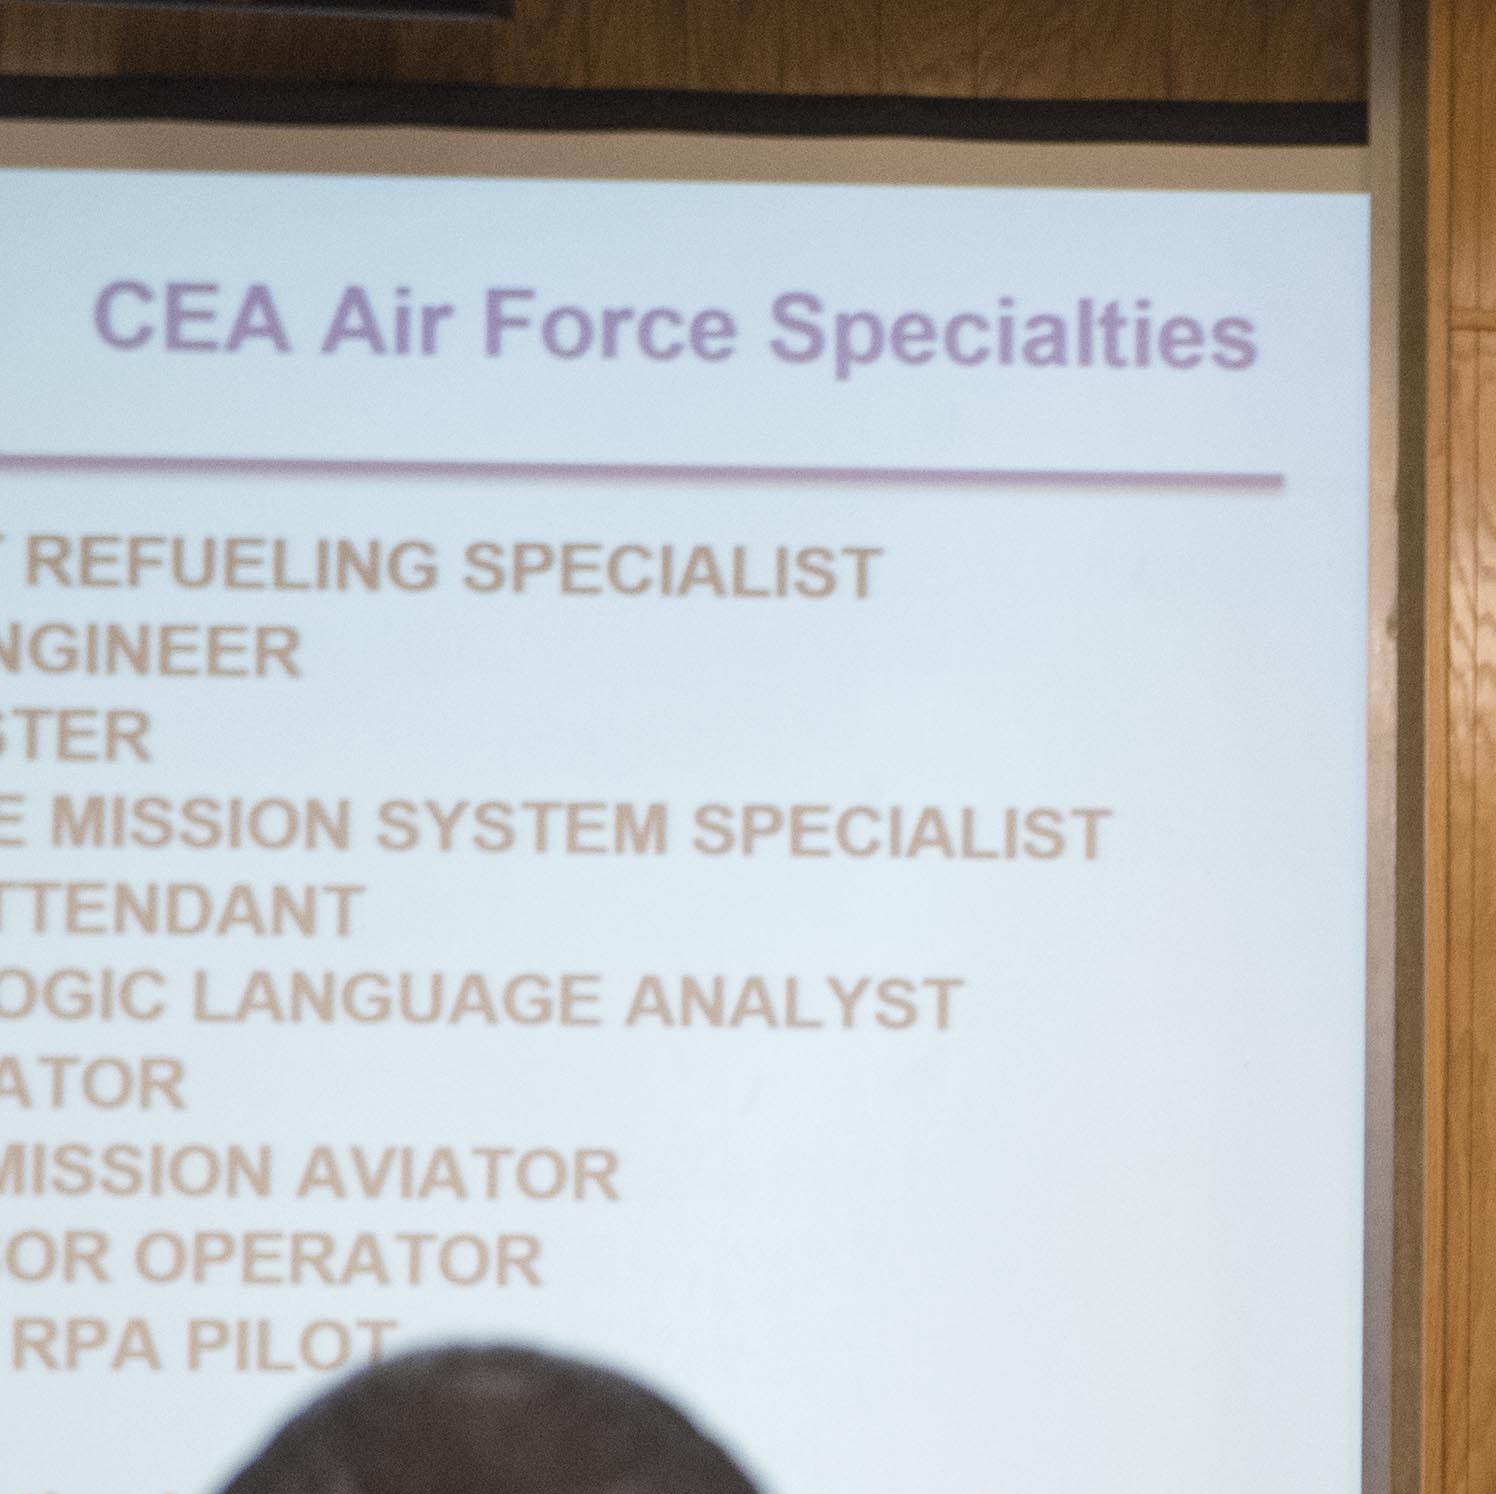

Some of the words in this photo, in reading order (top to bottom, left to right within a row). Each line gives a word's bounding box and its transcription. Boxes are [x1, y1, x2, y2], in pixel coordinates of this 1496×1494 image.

[93, 279, 292, 354] CEA
[320, 284, 455, 357] Air
[484, 287, 739, 363] Force
[769, 290, 1259, 382] Specialties
[24, 533, 439, 592] REFUELING
[462, 540, 884, 599] SPECIALIST
[0, 706, 152, 763] TER
[50, 793, 352, 851] MISSION
[376, 798, 669, 856] SYSTEM
[691, 803, 1115, 861] SPECIALIST
[192, 968, 602, 1028] LANGUAGE
[624, 974, 966, 1031] ANALYST
[294, 1144, 621, 1202] AVIATOR
[4, 1228, 111, 1285] OR
[132, 1229, 543, 1288] OPERATOR
[11, 1316, 163, 1372] RPA
[186, 1317, 398, 1373] PILOT
